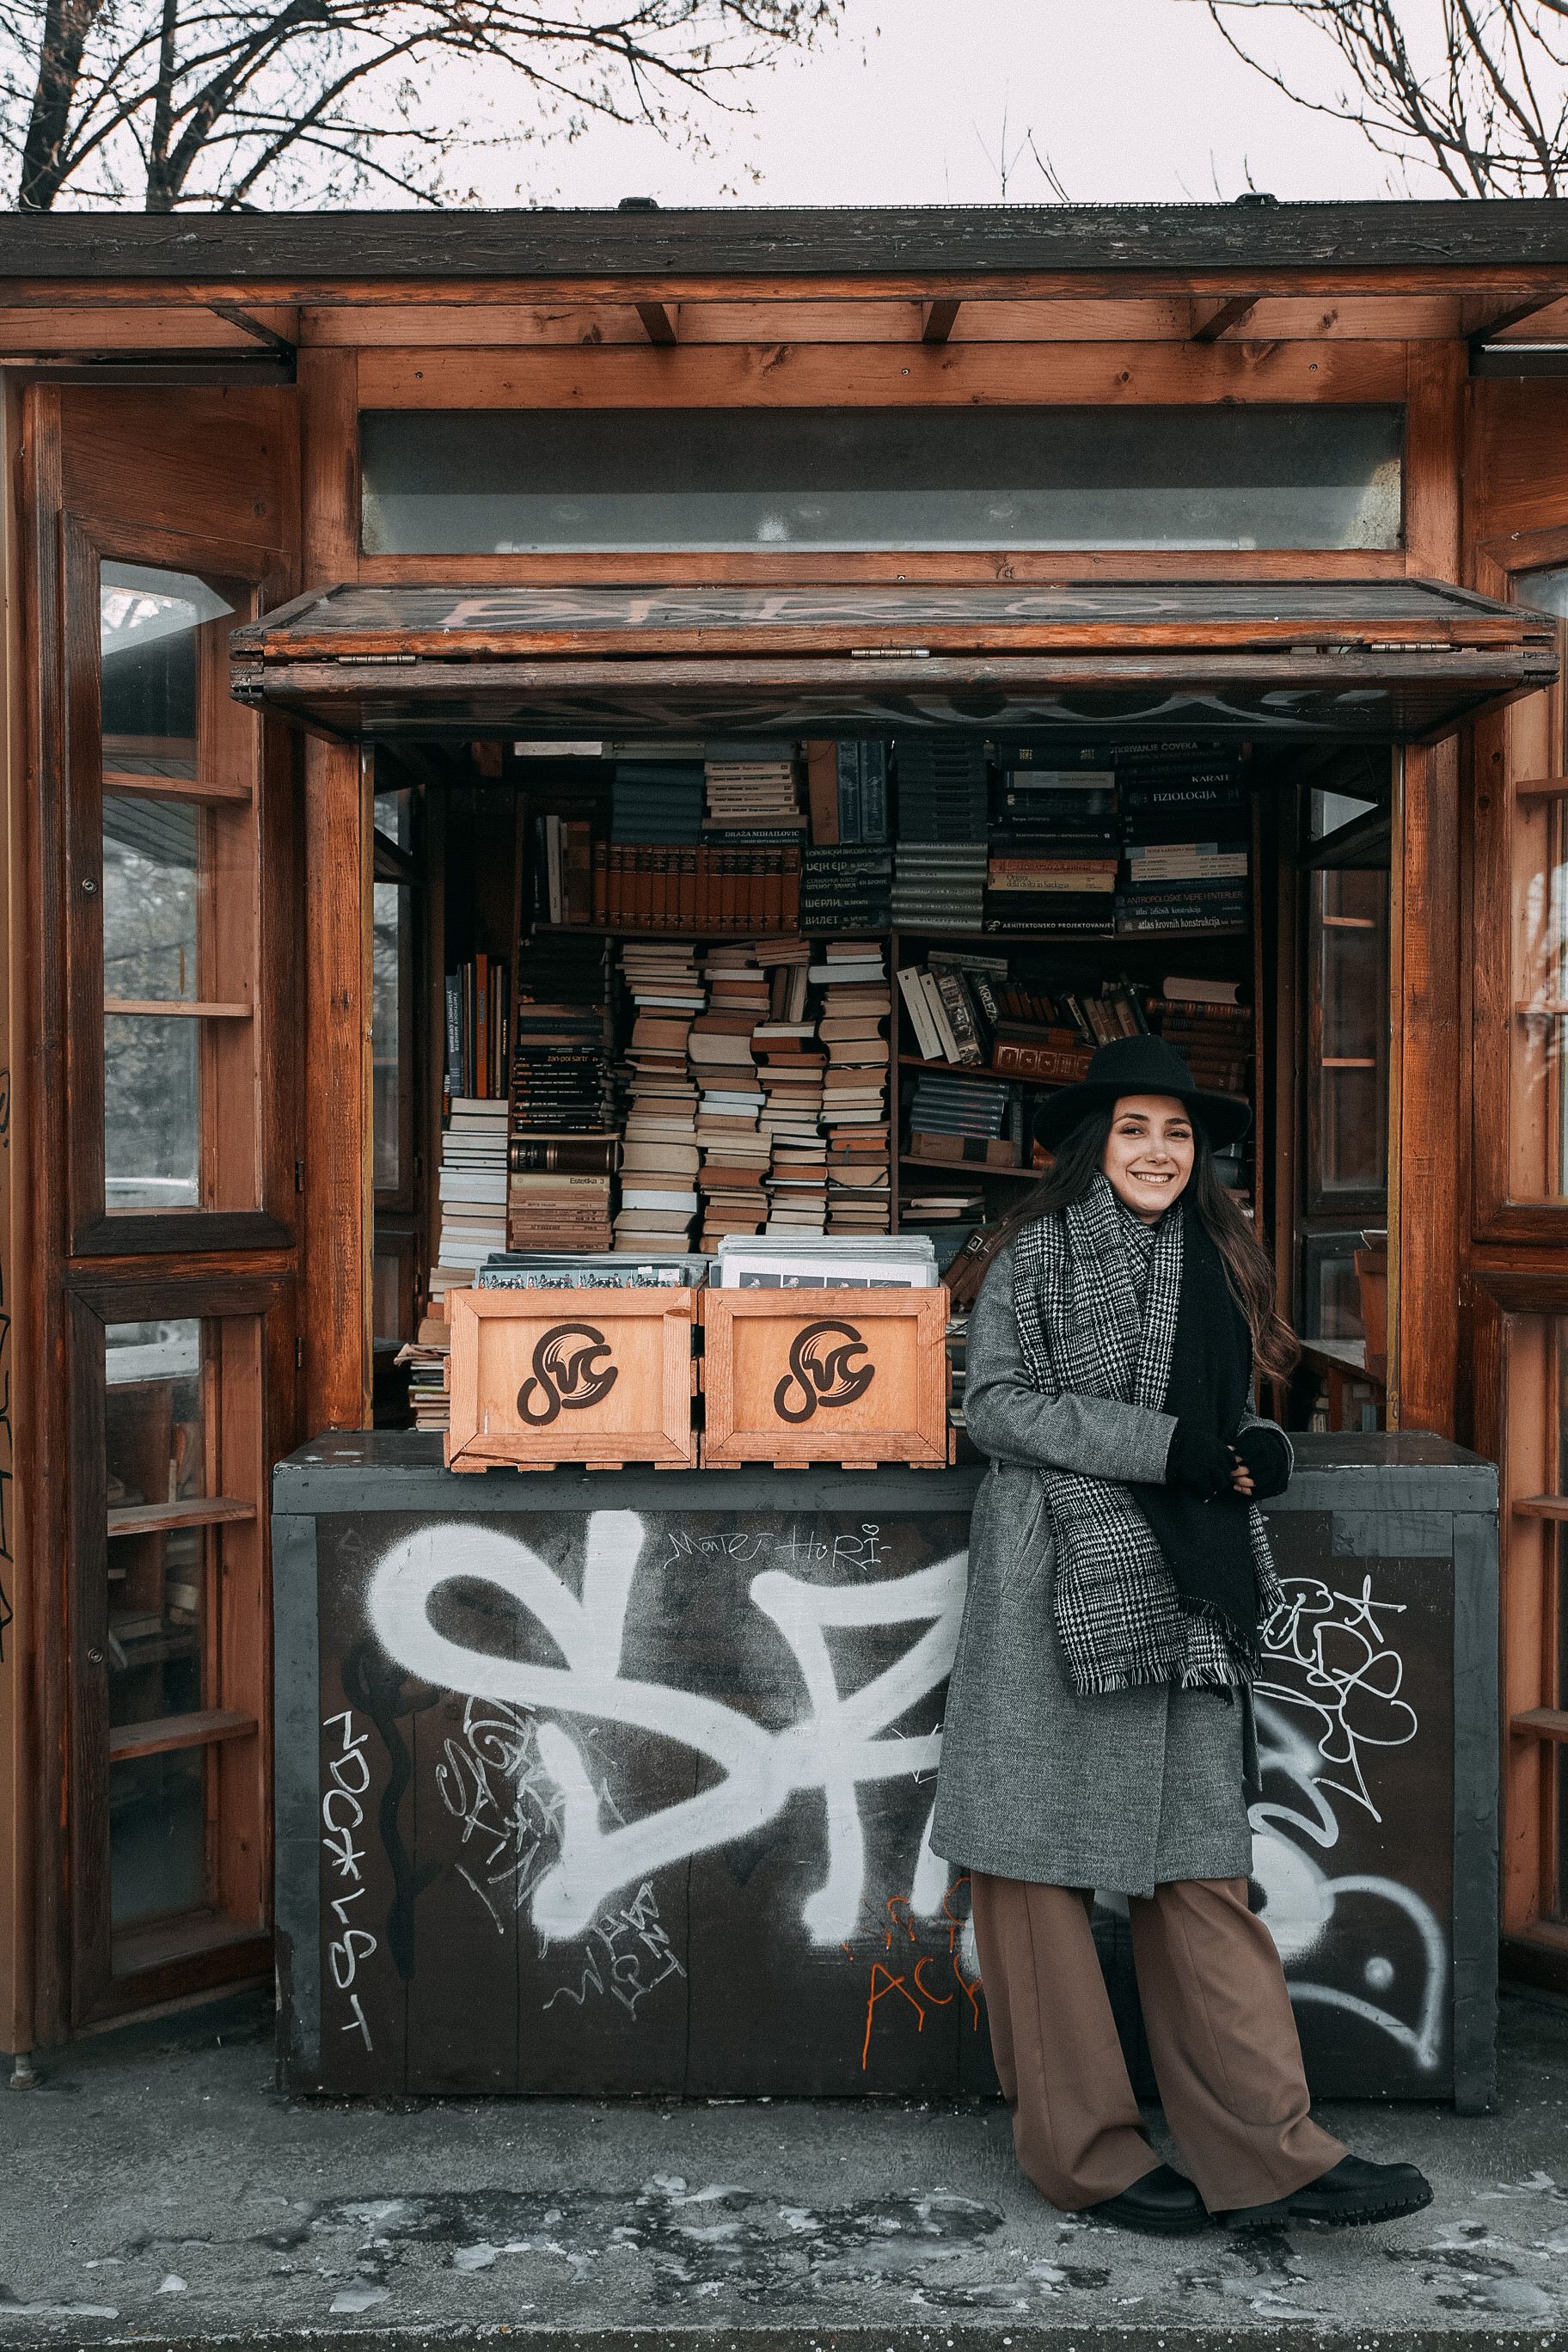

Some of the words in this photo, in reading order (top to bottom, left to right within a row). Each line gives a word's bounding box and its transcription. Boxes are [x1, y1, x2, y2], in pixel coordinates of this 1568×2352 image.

[1191, 774, 1230, 782] KARATE
[1153, 790, 1217, 801] FIZIOLOGIJA
[805, 898, 840, 908] ШЕРЛИ
[805, 916, 839, 925] ВИЛЕТ
[1137, 918, 1155, 929] atlas
[1155, 917, 1180, 928] krovnih
[1180, 916, 1220, 928] konstrukcija
[569, 1176, 597, 1185] Estetika
